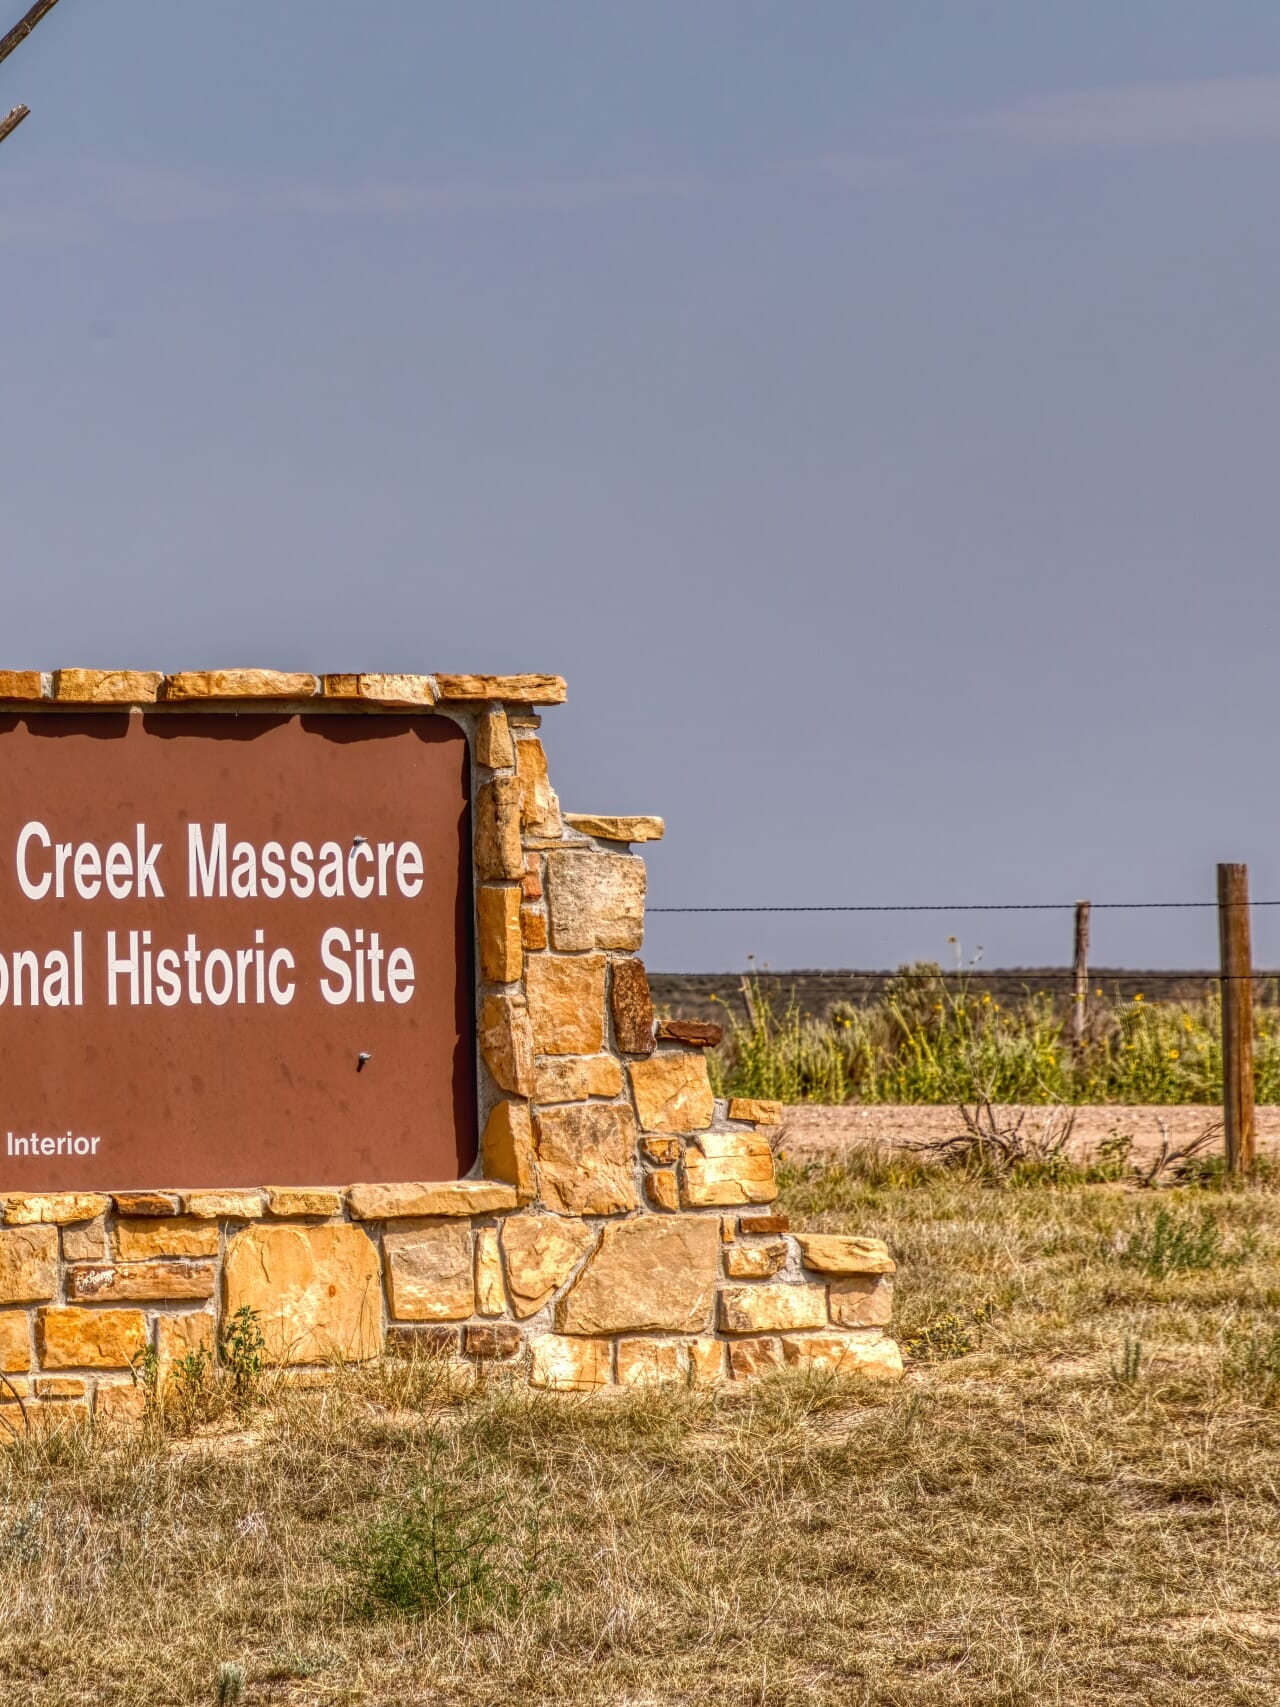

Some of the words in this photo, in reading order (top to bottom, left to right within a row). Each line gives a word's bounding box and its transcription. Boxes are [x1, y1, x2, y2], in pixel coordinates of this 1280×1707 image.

[16, 821, 165, 900] Creek
[188, 822, 424, 899] Massacre
[107, 929, 296, 1007] Historic
[319, 926, 415, 1005] Site
[7, 1131, 101, 1156] Interior
